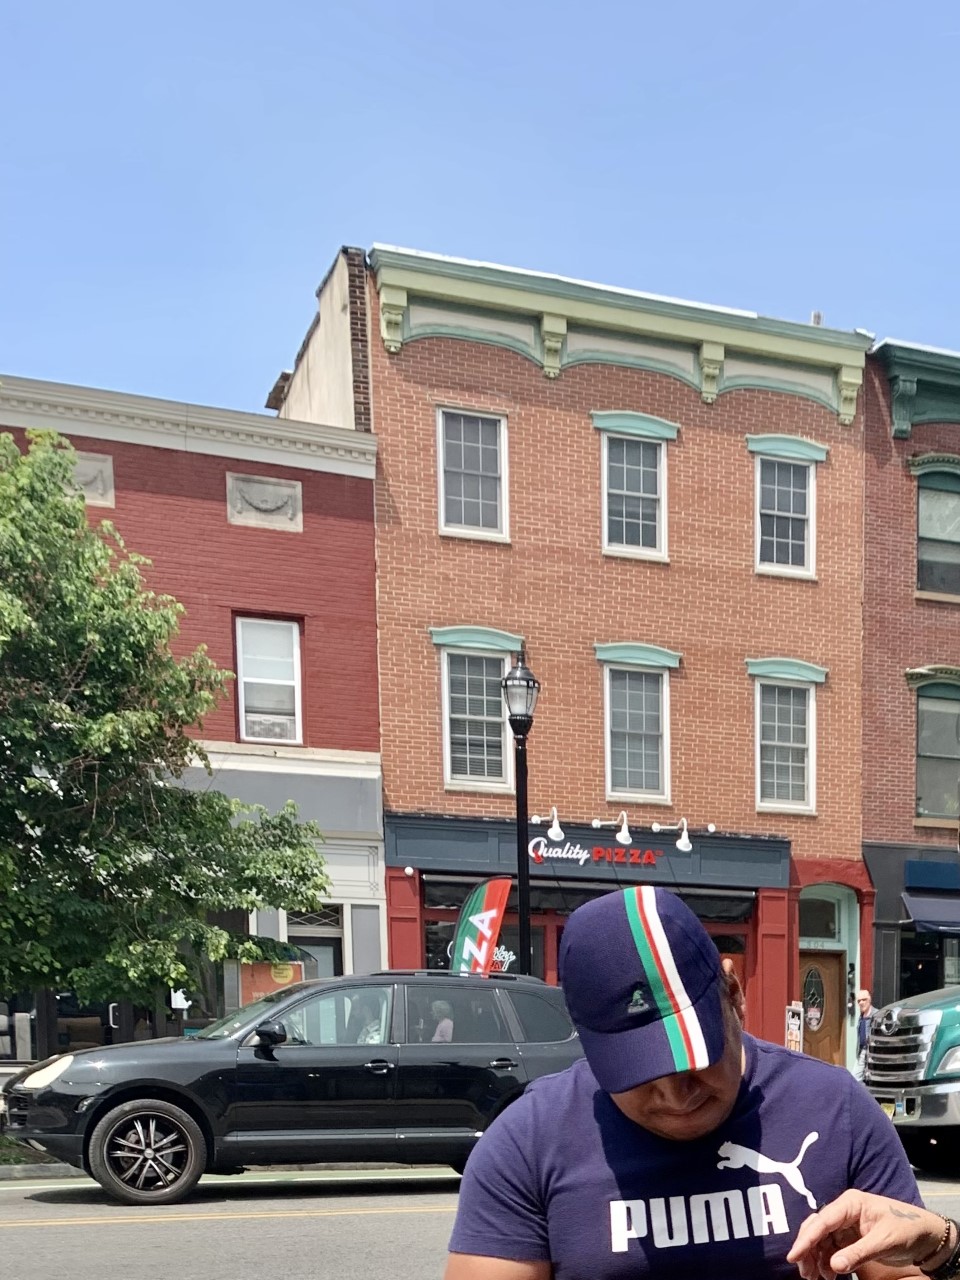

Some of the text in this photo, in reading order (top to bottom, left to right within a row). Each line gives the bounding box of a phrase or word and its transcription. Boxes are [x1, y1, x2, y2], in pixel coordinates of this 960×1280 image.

[528, 836, 657, 866] Quality PIZZA
[609, 1183, 790, 1253] PUMA
